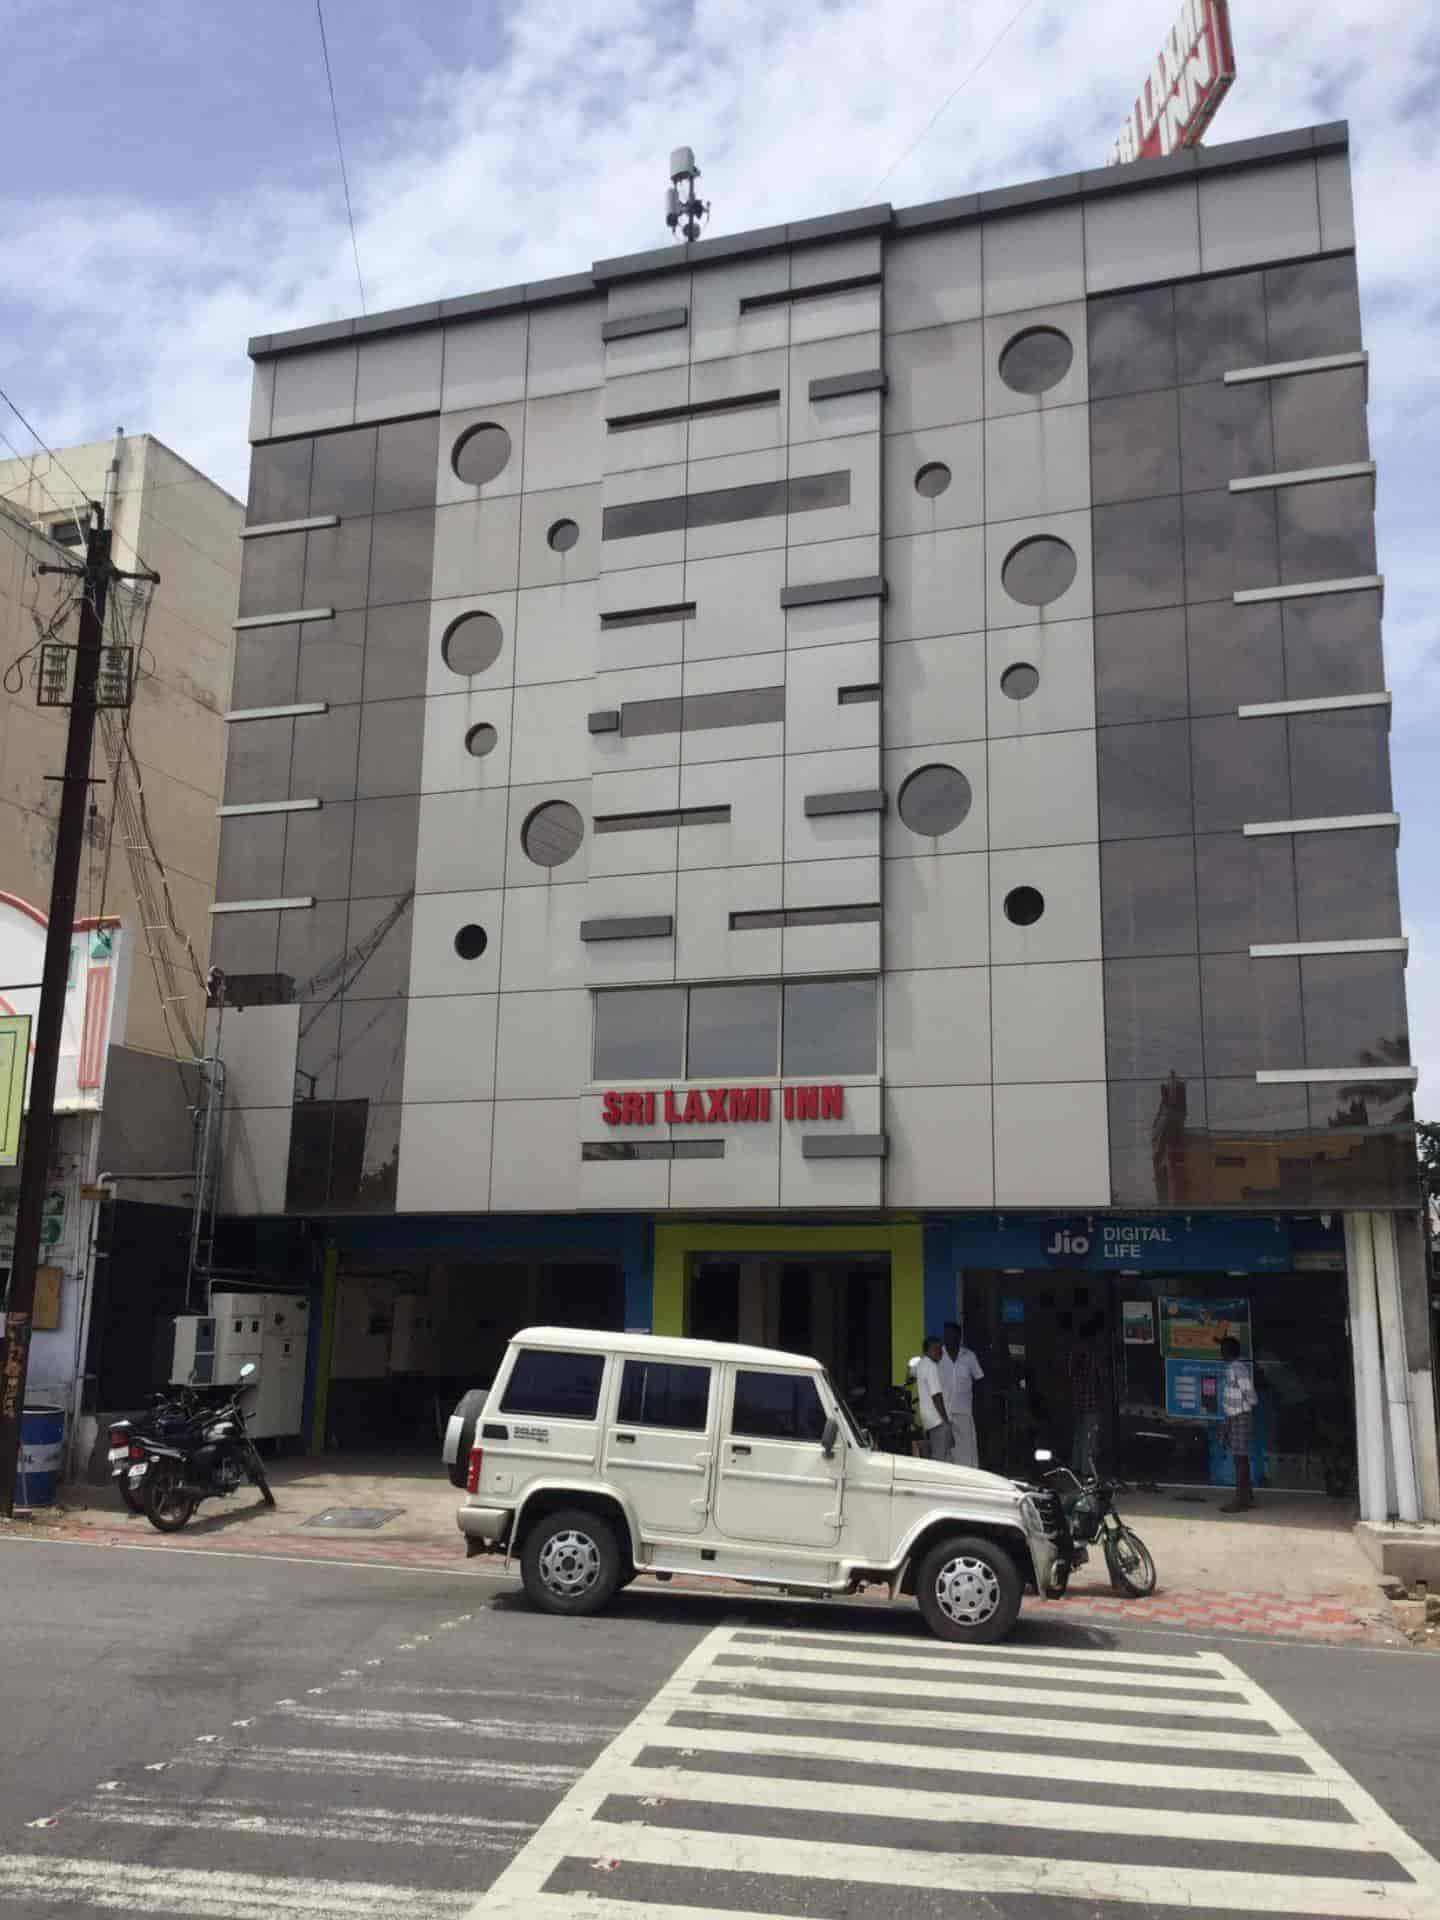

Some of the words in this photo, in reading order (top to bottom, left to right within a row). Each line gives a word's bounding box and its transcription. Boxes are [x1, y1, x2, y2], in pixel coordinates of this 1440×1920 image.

[602, 1091, 655, 1125] SRI
[664, 1087, 771, 1123] LAXMI
[783, 1085, 844, 1120] INN
[1047, 1230, 1089, 1254] Jio
[1103, 1227, 1171, 1241] DIGITAL
[1104, 1244, 1142, 1258] LIFE
